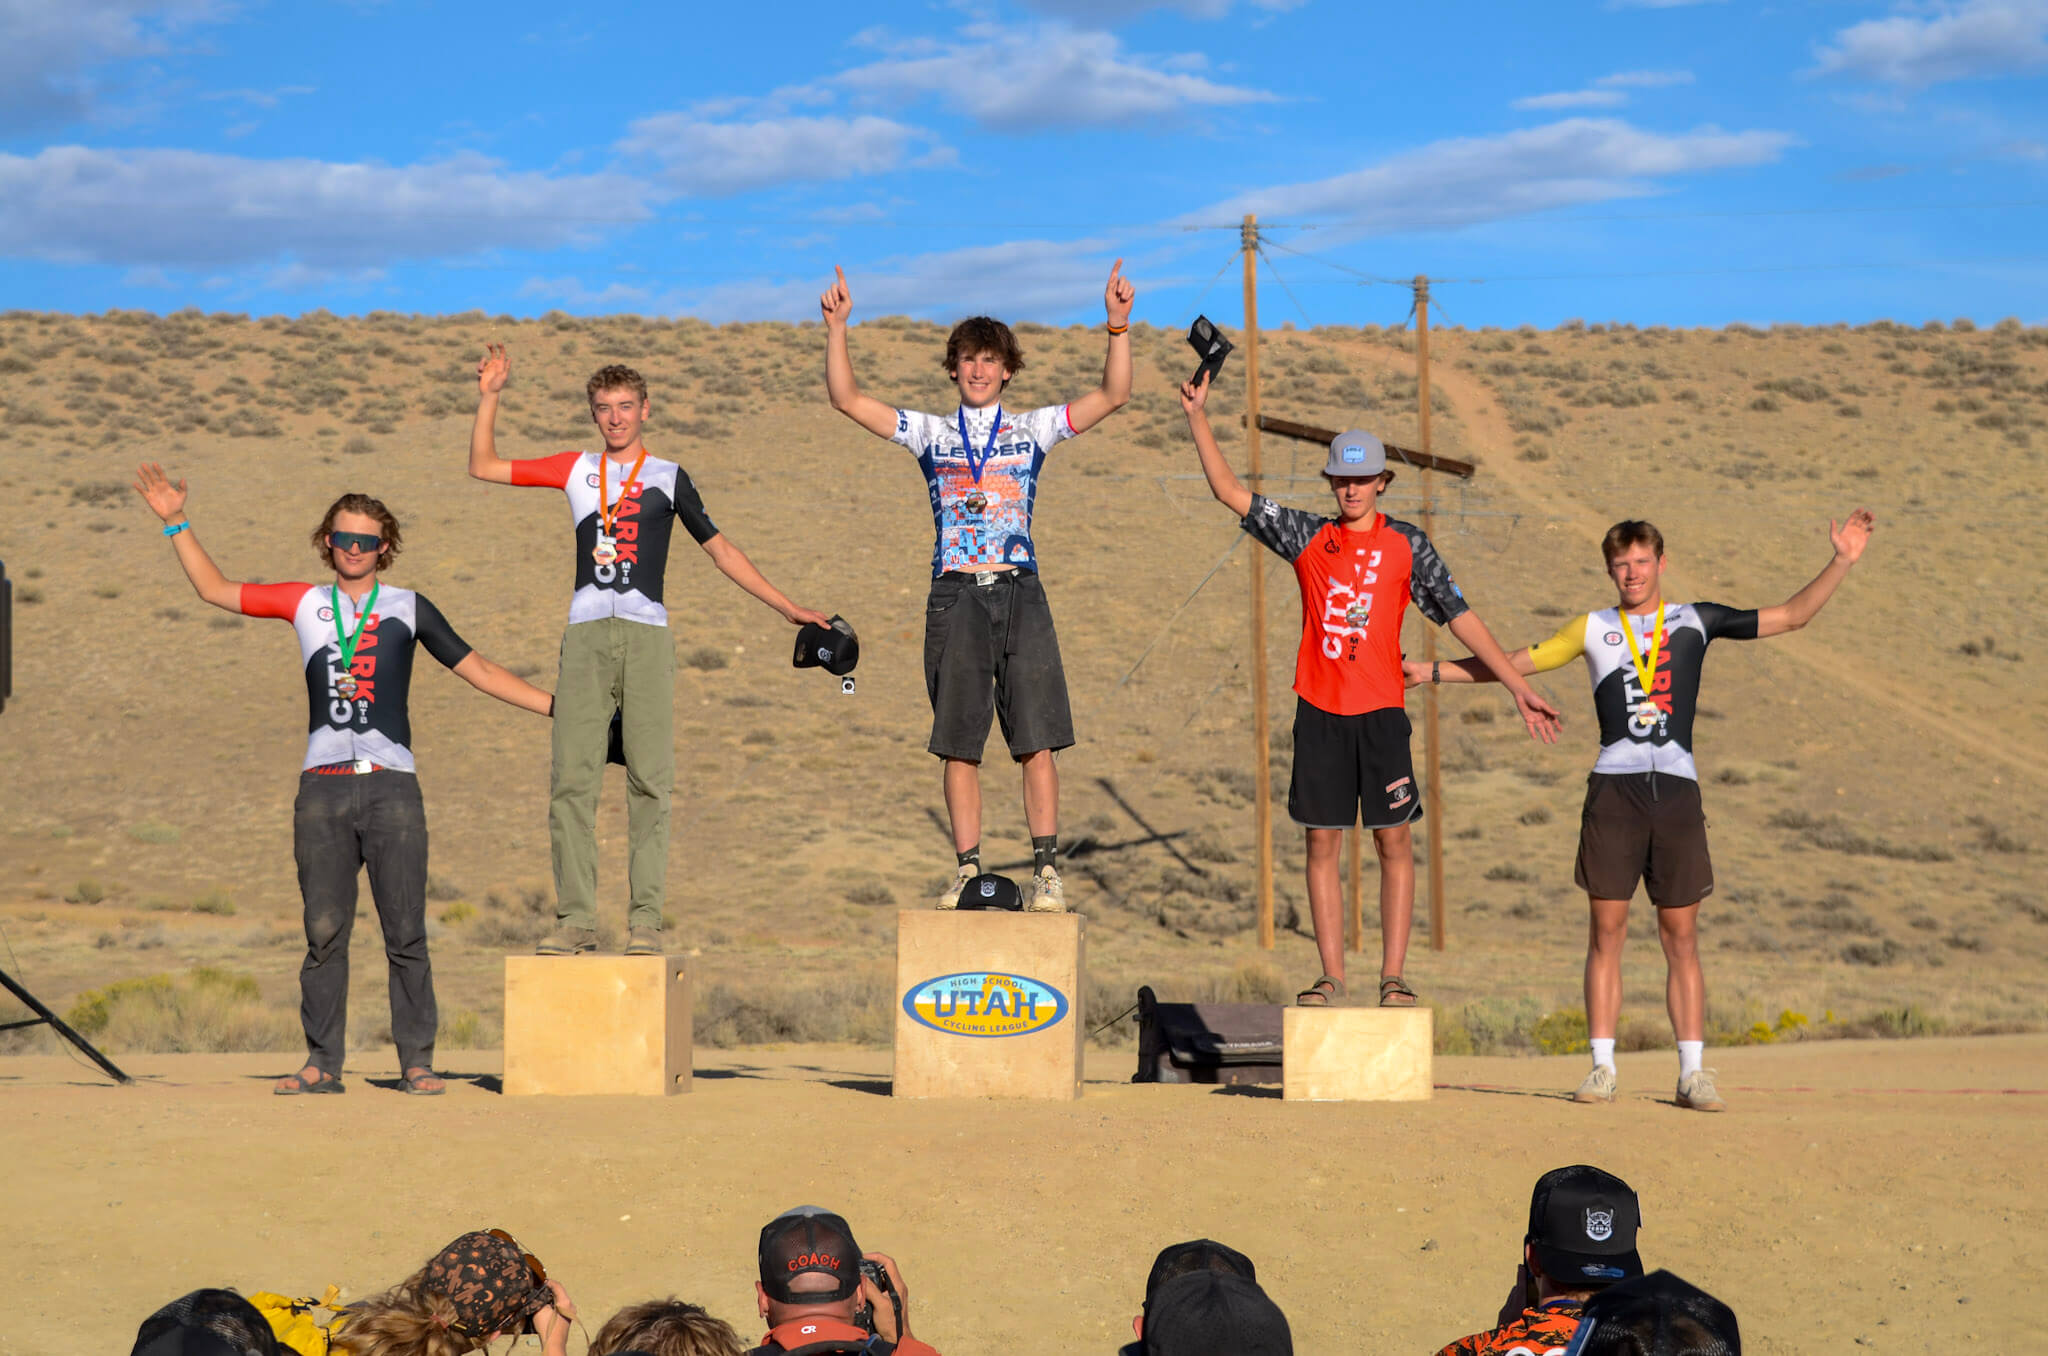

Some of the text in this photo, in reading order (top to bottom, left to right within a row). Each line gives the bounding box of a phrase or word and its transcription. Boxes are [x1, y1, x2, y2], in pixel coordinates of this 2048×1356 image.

[935, 441, 1031, 459] LEADER
[615, 481, 644, 564] PARK
[1322, 575, 1356, 659] CITY
[350, 612, 380, 704] PARK
[1349, 637, 1359, 661] MTB
[1643, 628, 1673, 715] PARK
[950, 977, 1024, 990] HIGH SCHOOL
[933, 990, 1039, 1021] UTAH
[943, 1019, 1028, 1033] CYCLING LEAGUE
[787, 1252, 841, 1272] COACH
